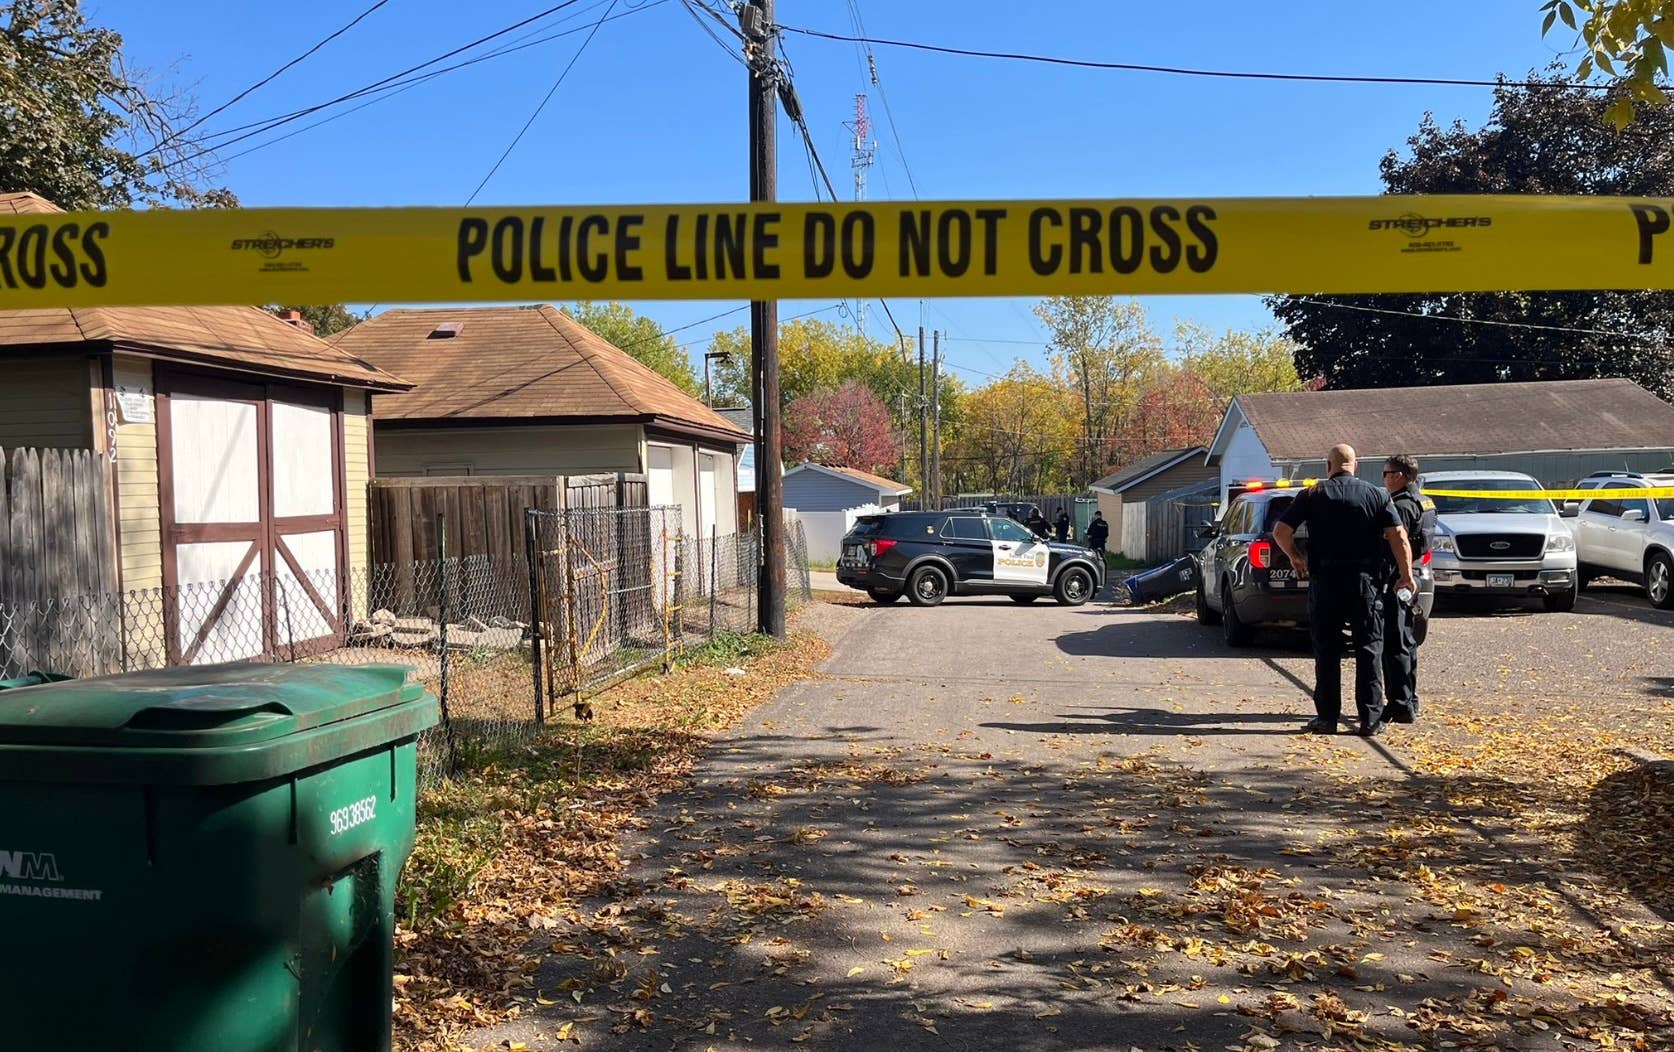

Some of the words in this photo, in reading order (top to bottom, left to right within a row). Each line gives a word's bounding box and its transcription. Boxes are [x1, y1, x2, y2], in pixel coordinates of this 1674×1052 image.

[457, 214, 644, 284] POLICE
[664, 213, 781, 281] LINE
[803, 210, 875, 280] DO
[899, 209, 1007, 278] NOT
[1028, 205, 1218, 275] CROSS
[107, 391, 117, 464] 1092
[998, 558, 1034, 568] POLICE
[0, 884, 102, 901] MANAGEMENT
